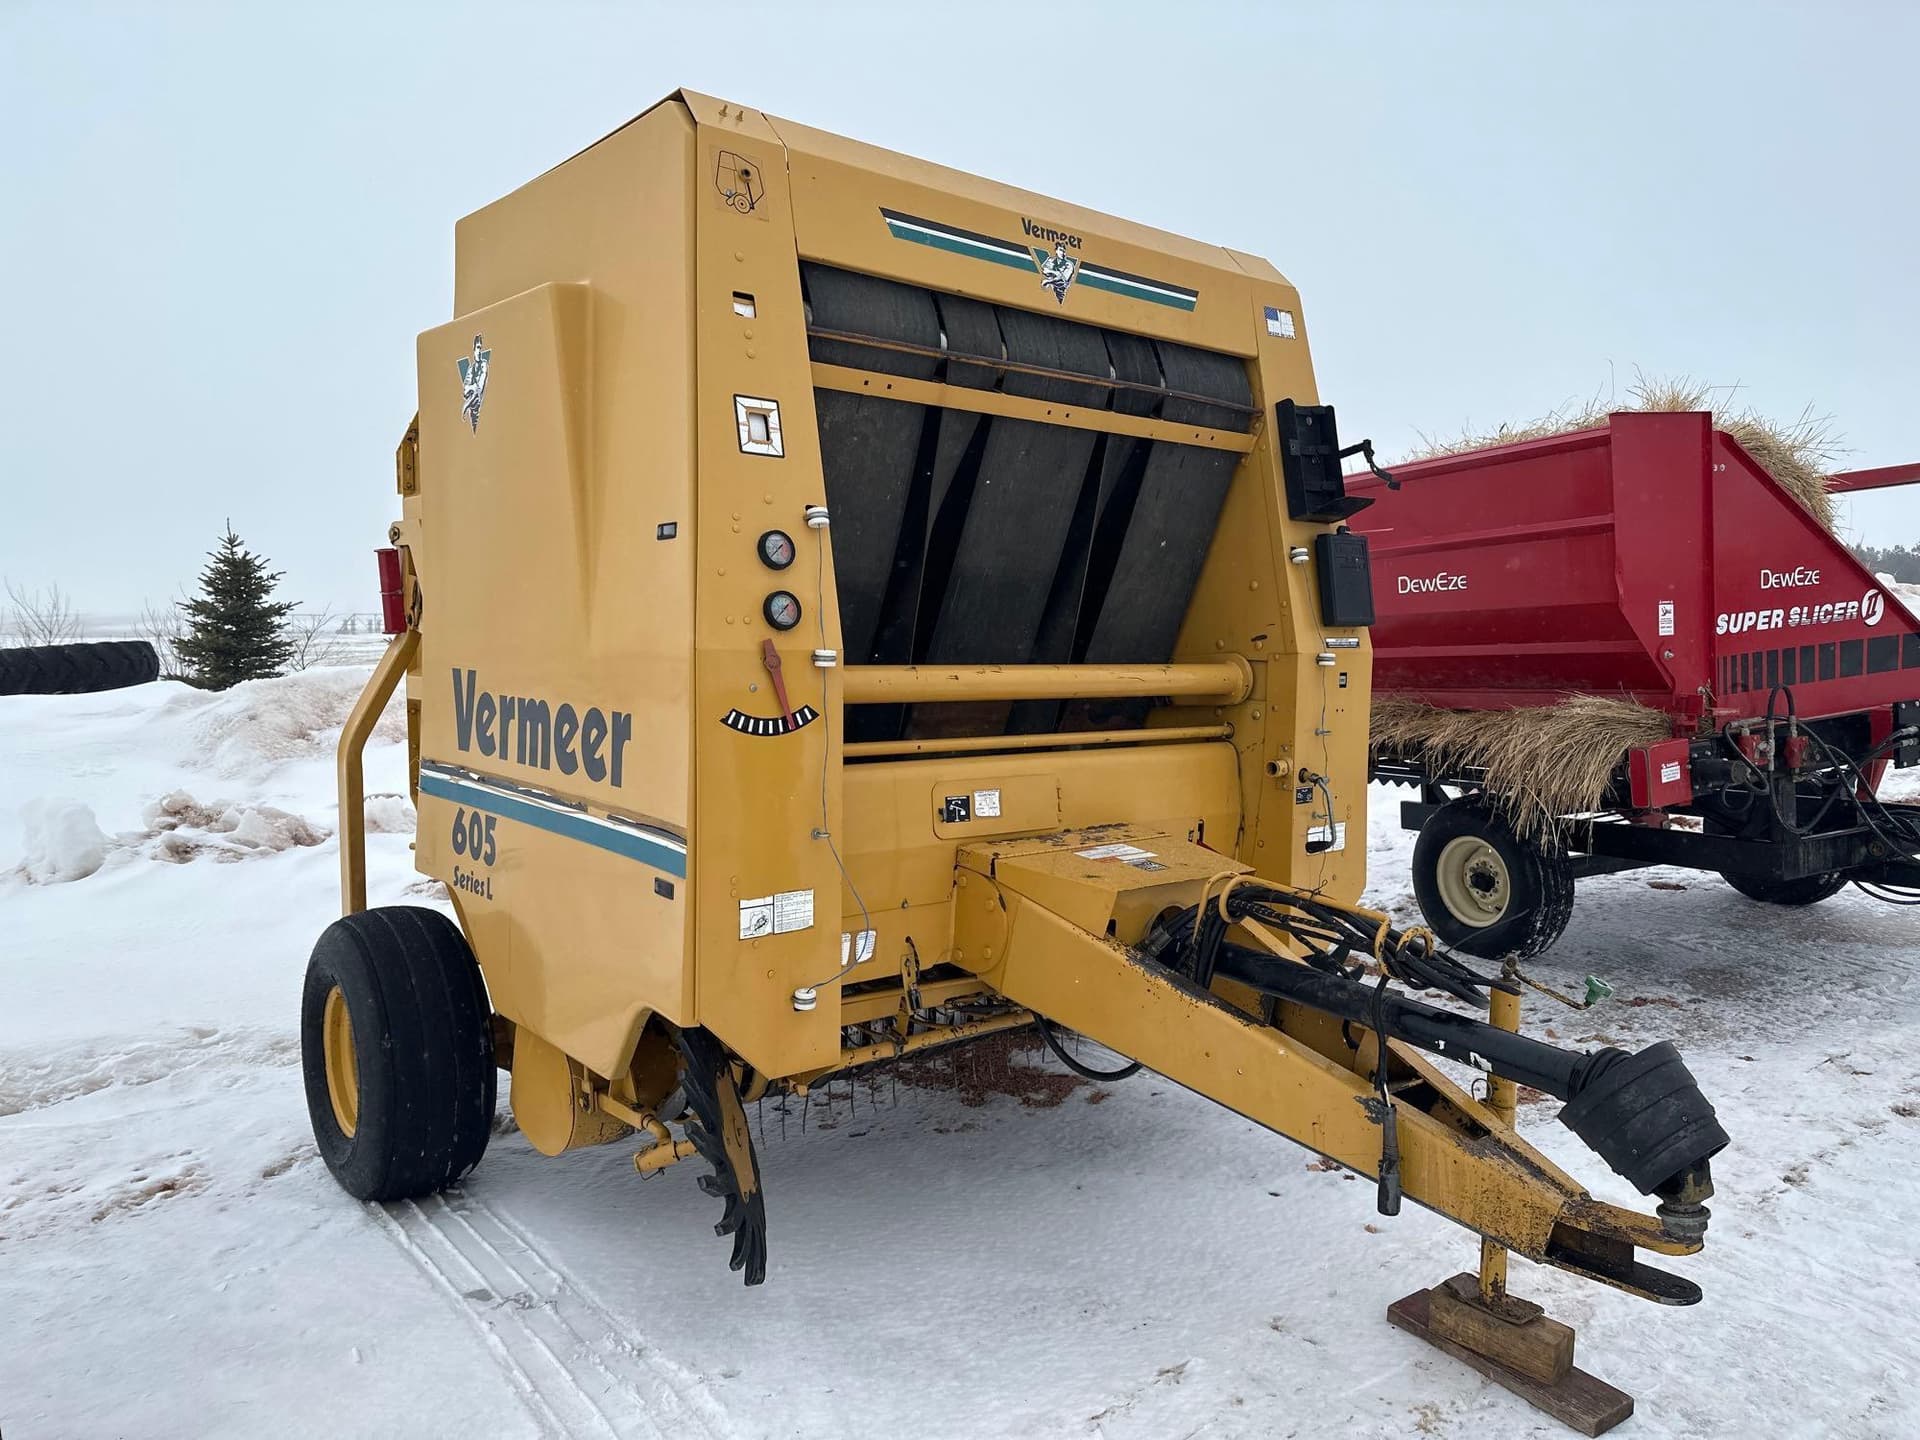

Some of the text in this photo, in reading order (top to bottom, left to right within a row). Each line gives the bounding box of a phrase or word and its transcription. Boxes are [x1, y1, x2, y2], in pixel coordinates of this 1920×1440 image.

[1715, 608, 1785, 635] SUPER
[1788, 600, 1859, 627] SLICER
[451, 667, 632, 788] Vermeer
[451, 806, 497, 867] 605
[453, 865, 493, 900] Series L
